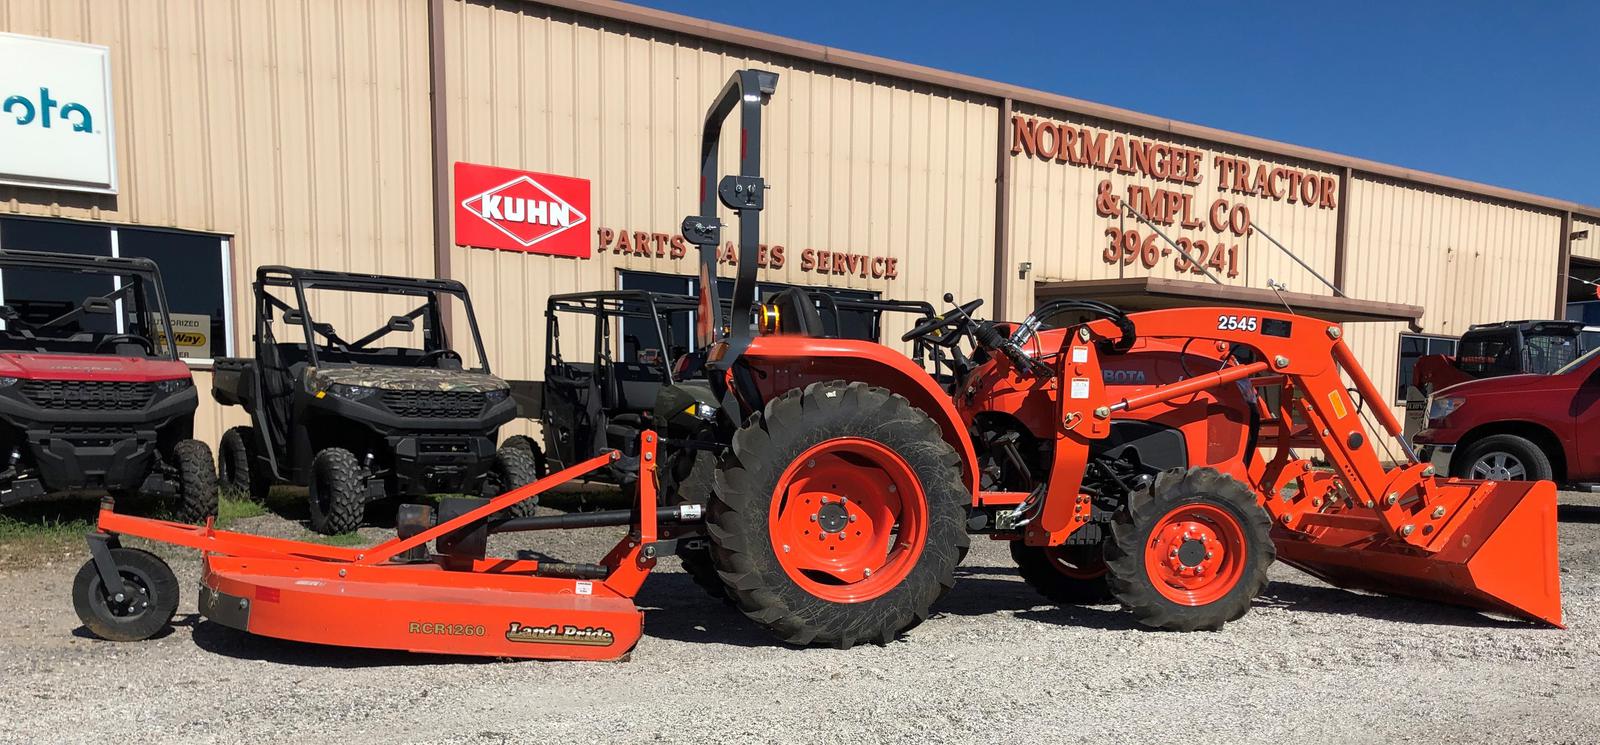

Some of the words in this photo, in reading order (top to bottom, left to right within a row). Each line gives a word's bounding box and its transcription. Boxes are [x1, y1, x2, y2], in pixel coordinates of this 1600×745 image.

[1011, 115, 1204, 186] NORMANGEE
[1214, 155, 1338, 210] TRACTOR
[481, 194, 570, 227] KUHN
[1096, 179, 1124, 218] &
[597, 227, 687, 260] PARTS
[716, 241, 786, 270] AES
[801, 248, 899, 281] SERVICE
[1102, 226, 1240, 279] 396-3241
[1218, 316, 1257, 331] 2545
[1101, 370, 1145, 382] BOTA
[409, 622, 486, 636] RCR1260
[508, 622, 558, 639] Land
[563, 625, 613, 642] Pride
